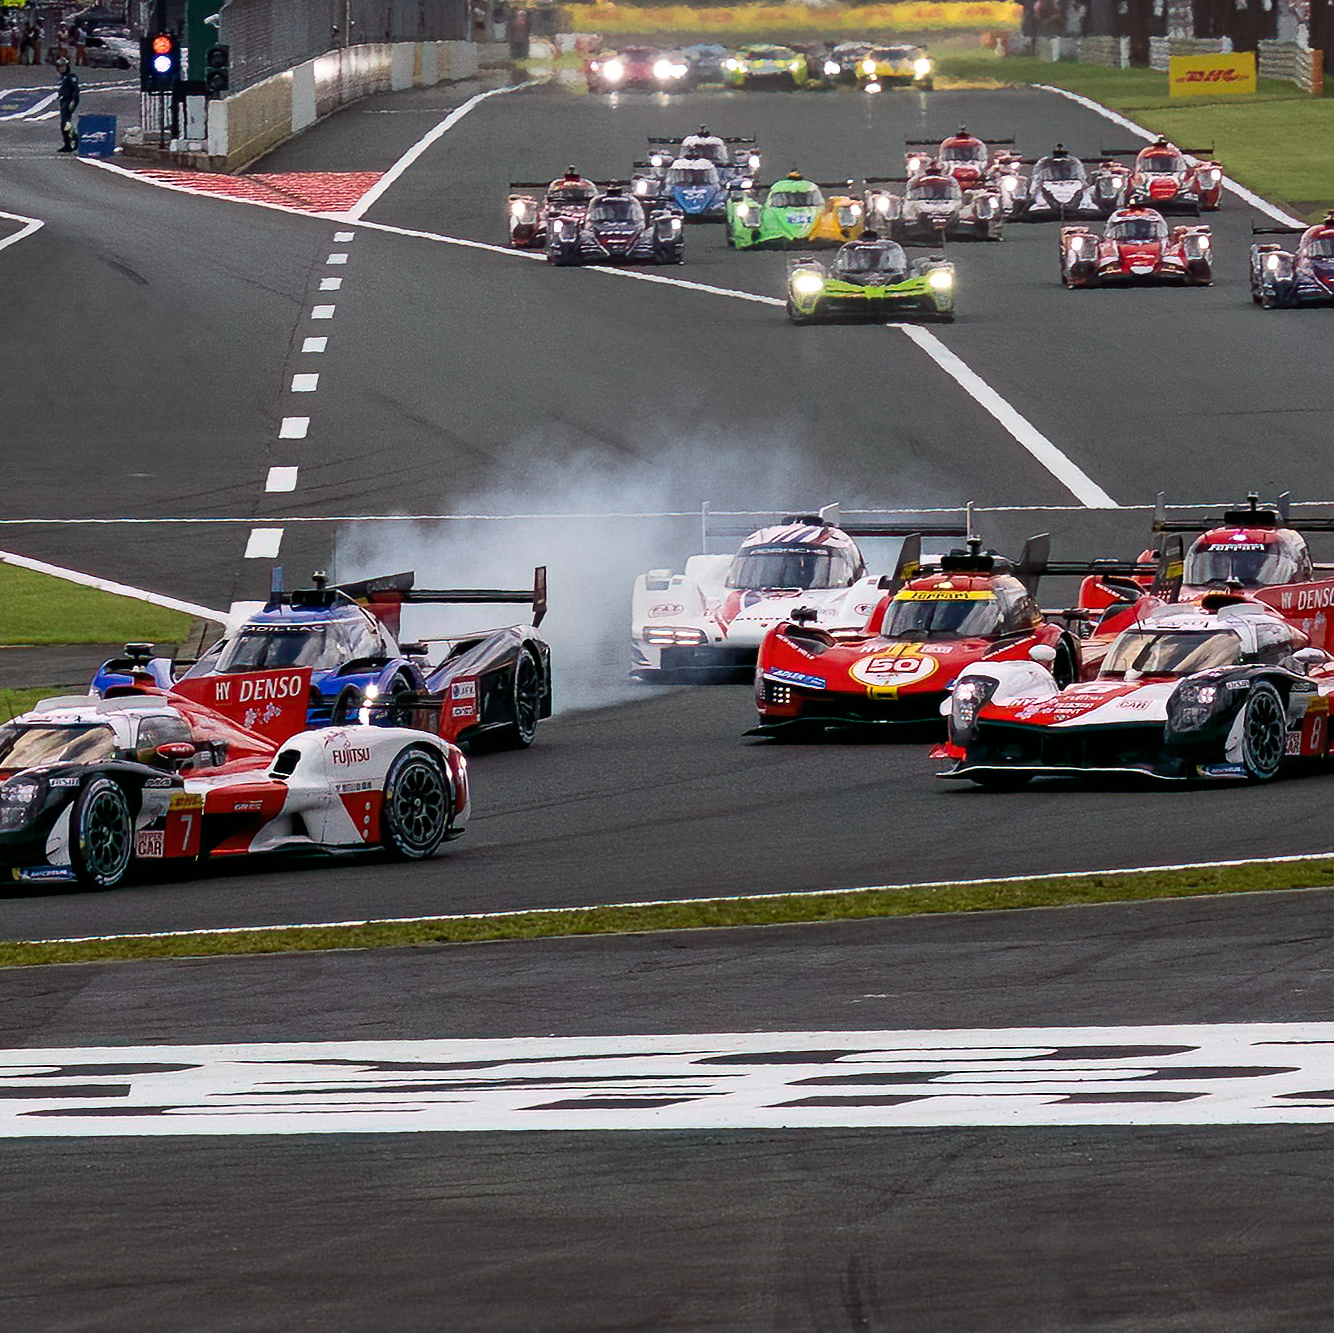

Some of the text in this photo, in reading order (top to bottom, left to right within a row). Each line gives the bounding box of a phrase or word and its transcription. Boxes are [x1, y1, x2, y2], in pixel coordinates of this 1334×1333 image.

[1184, 69, 1240, 83] DHL
[1208, 543, 1265, 552] Ferrari
[911, 591, 970, 600] Ferrari
[867, 658, 921, 672] 50
[215, 675, 302, 702] HY DENSO
[332, 747, 371, 767] FUJITSU
[181, 814, 194, 851] 7
[138, 840, 163, 856] CAR
